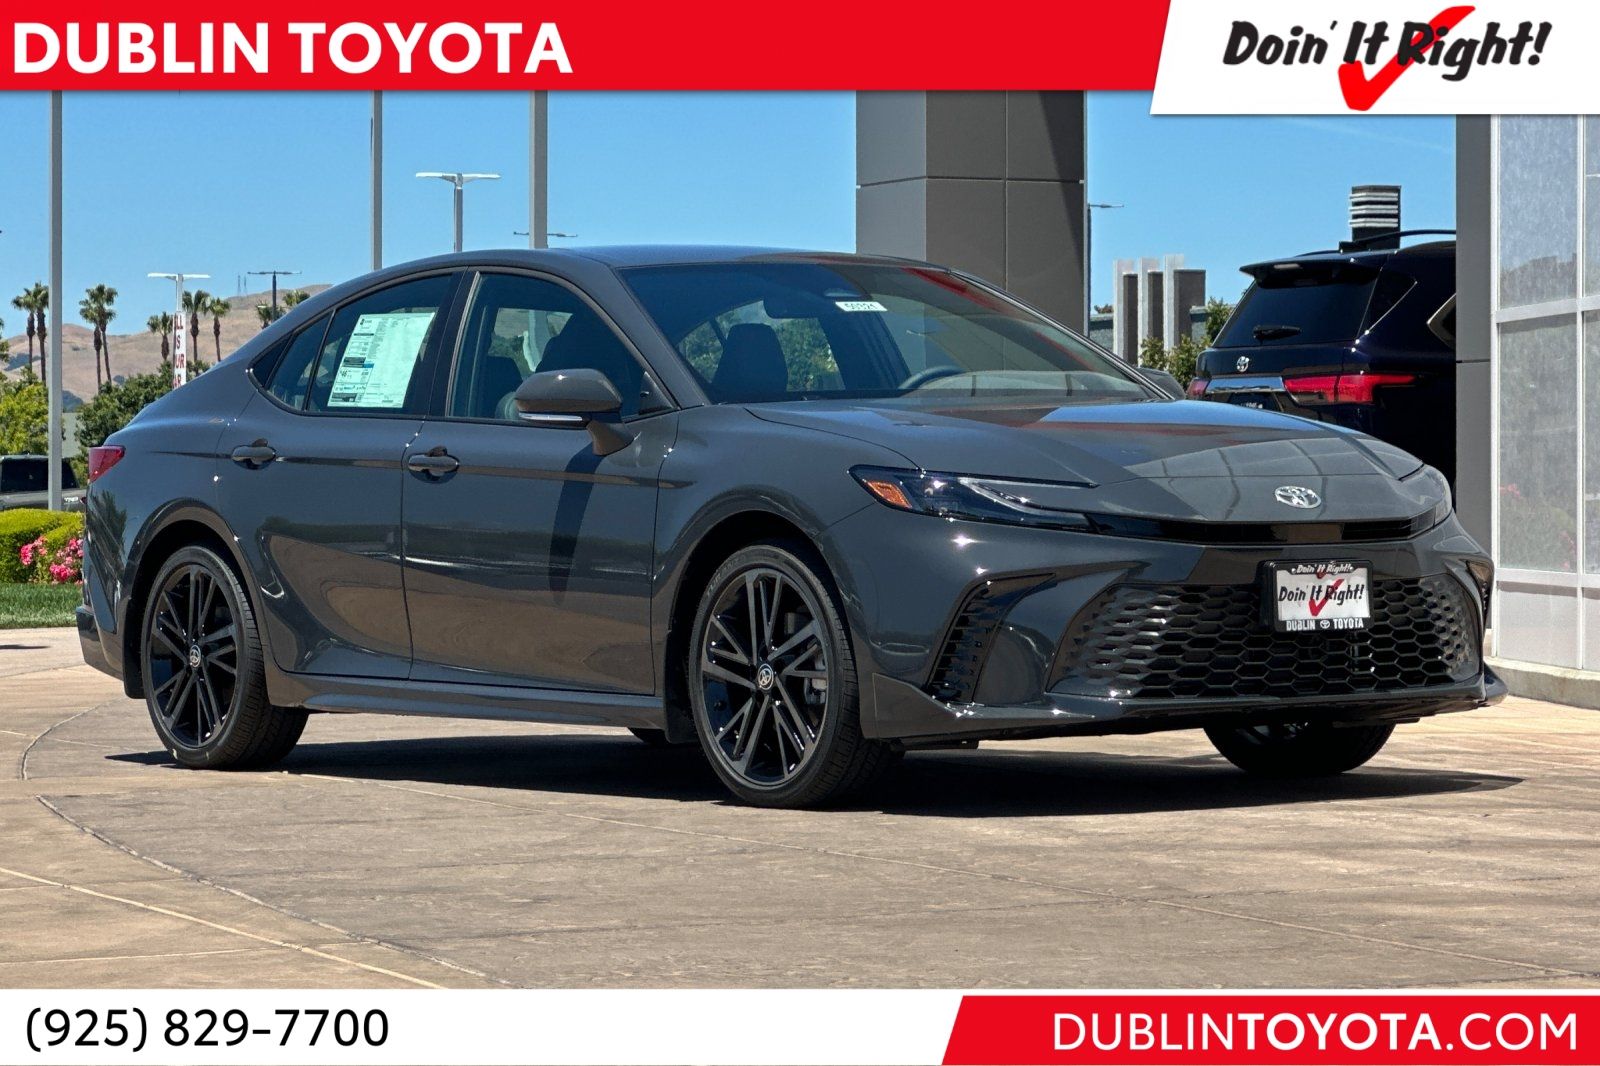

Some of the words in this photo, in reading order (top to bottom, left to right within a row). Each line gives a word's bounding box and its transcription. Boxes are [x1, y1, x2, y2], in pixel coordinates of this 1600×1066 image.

[1296, 564, 1317, 574] Doin'
[1317, 564, 1326, 573] It
[1326, 564, 1351, 575] Right!
[1278, 585, 1309, 602] Doin'
[1310, 585, 1323, 601] It
[1325, 584, 1365, 606] Right!
[1286, 619, 1316, 631] DUBLIN
[1333, 618, 1364, 630] TOYOTA
